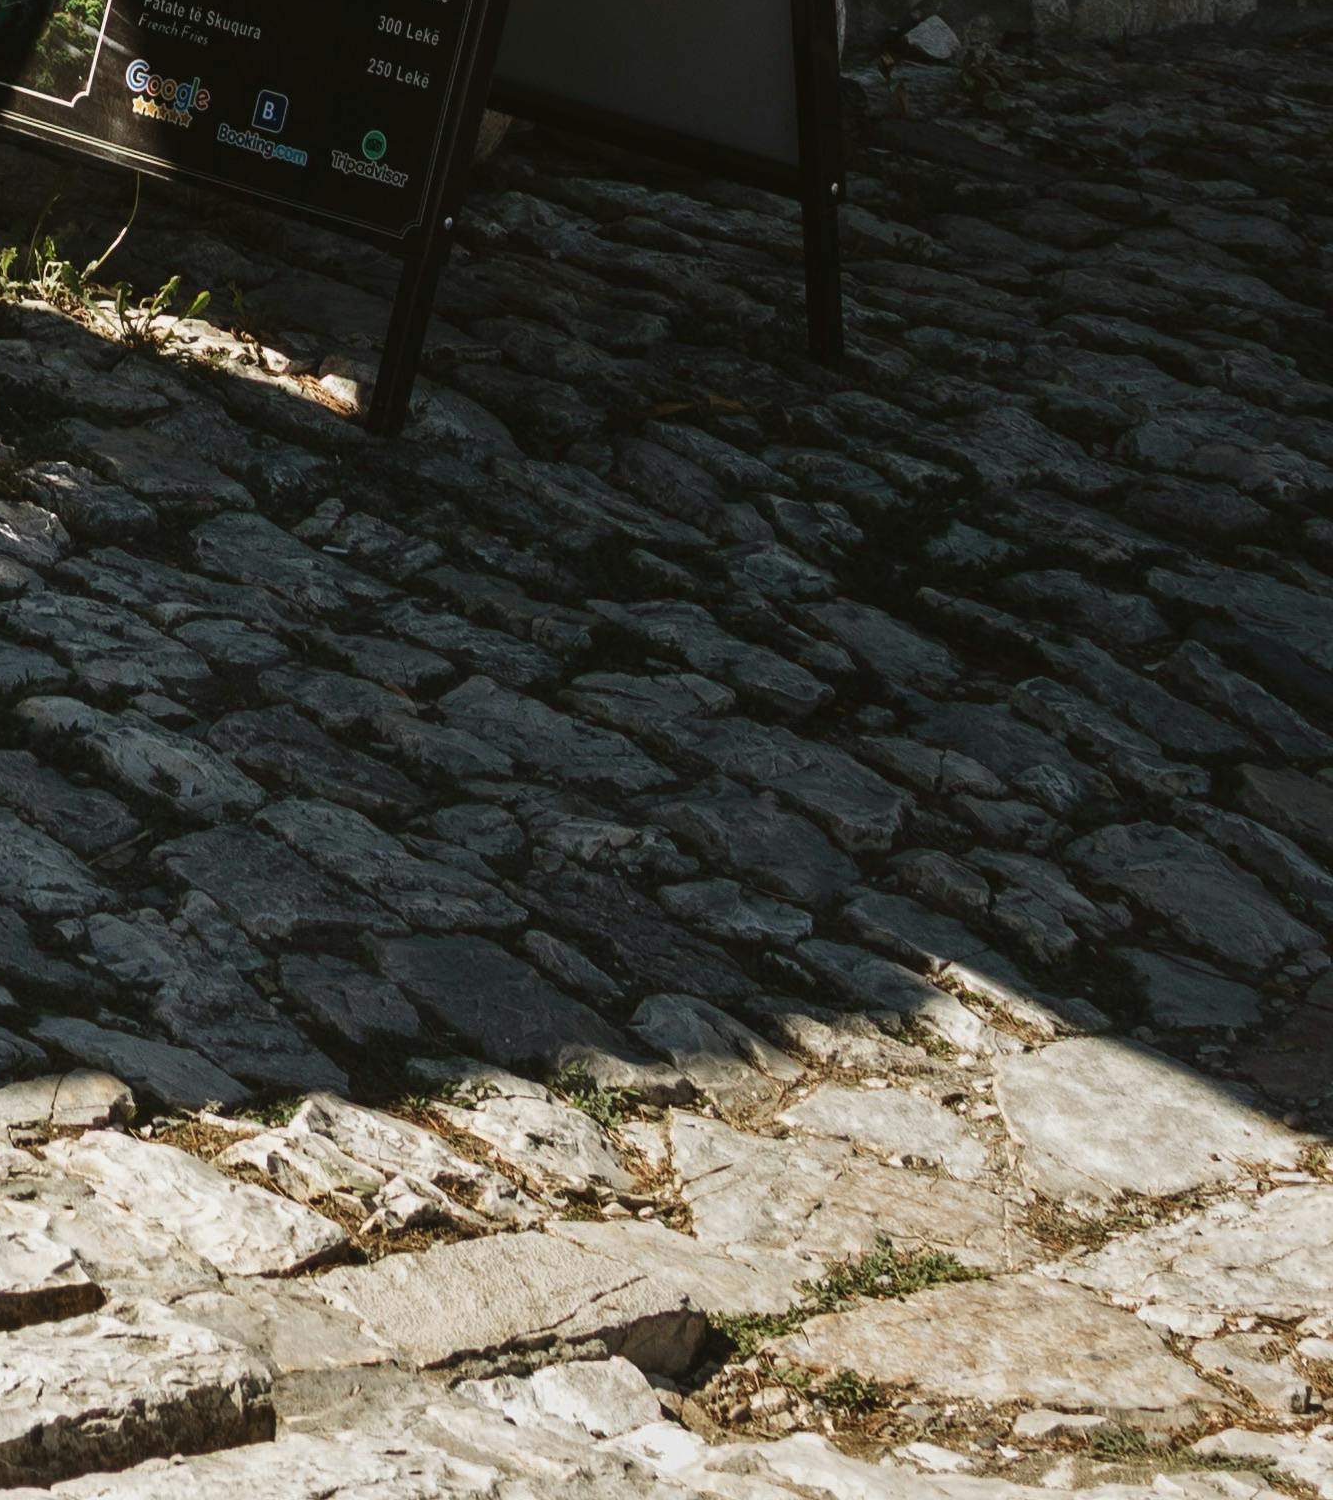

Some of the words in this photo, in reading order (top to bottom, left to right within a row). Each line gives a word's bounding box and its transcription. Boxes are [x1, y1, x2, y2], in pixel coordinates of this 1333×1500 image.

[204, 9, 262, 41] Skuqura
[376, 14, 404, 37] 300
[125, 57, 210, 111] Google
[216, 122, 308, 166] Booking.com
[332, 150, 408, 189] Tripadvisor
